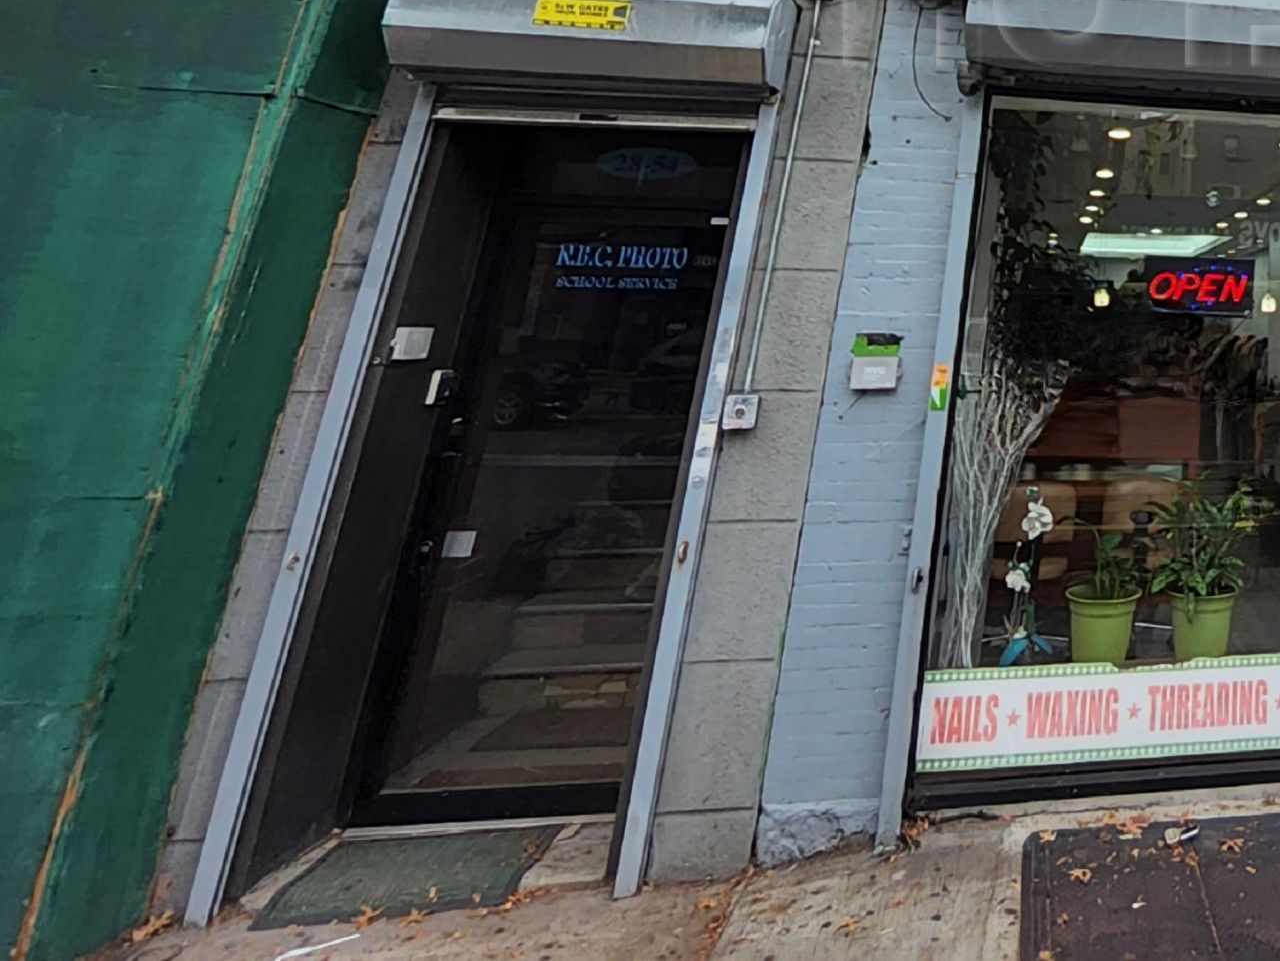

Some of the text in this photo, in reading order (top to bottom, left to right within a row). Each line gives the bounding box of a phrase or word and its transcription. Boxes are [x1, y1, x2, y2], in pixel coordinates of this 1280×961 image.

[616, 245, 689, 269] PHOTO
[555, 275, 616, 289] SCHOOL
[1148, 270, 1249, 303] OPEN
[929, 693, 1001, 745] NAILS
[1025, 687, 1121, 740] WAXING
[1147, 678, 1269, 733] THREADING
